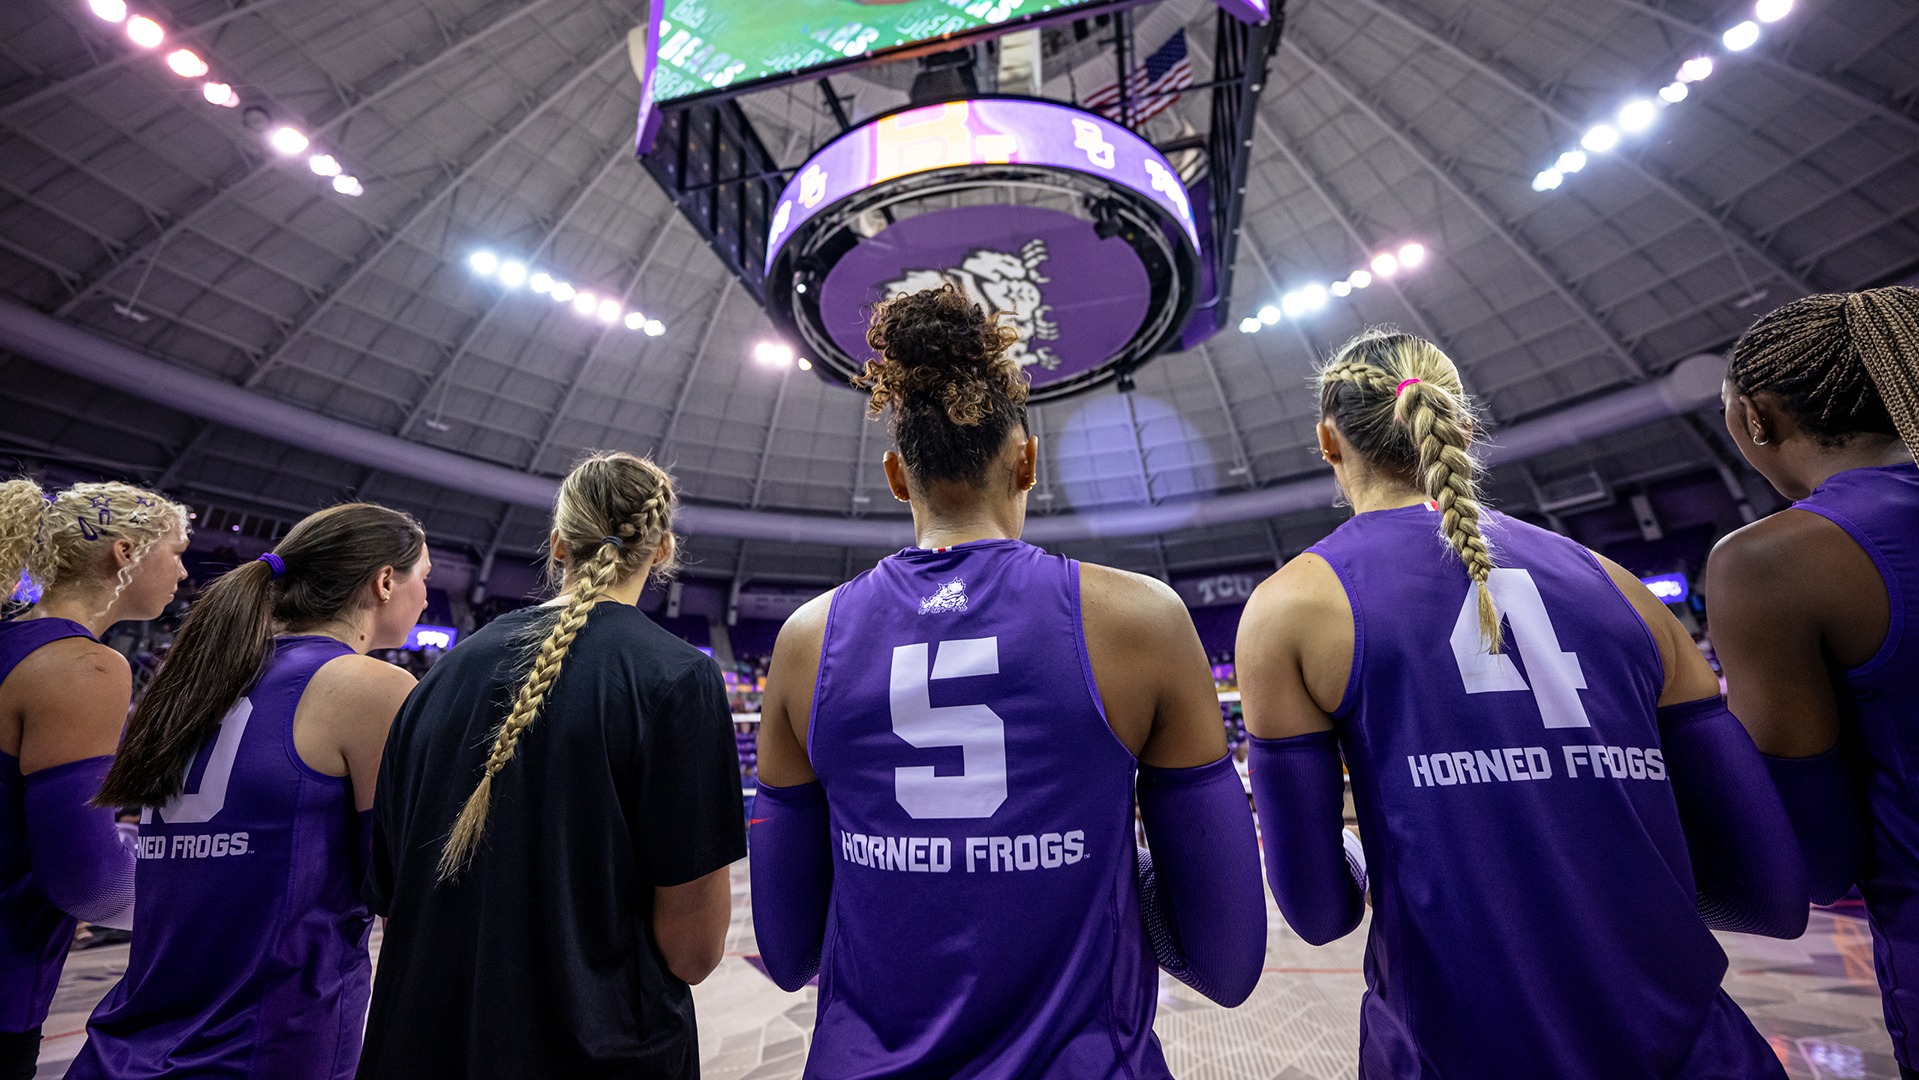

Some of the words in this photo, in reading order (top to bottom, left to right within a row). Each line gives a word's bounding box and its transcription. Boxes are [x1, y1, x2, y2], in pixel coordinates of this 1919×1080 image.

[1198, 574, 1253, 606] TCU
[1450, 568, 1591, 729] 4
[139, 696, 254, 825] 0
[889, 636, 1008, 819] 5
[1407, 746, 1553, 788] HORNED
[840, 829, 952, 874] HORNED
